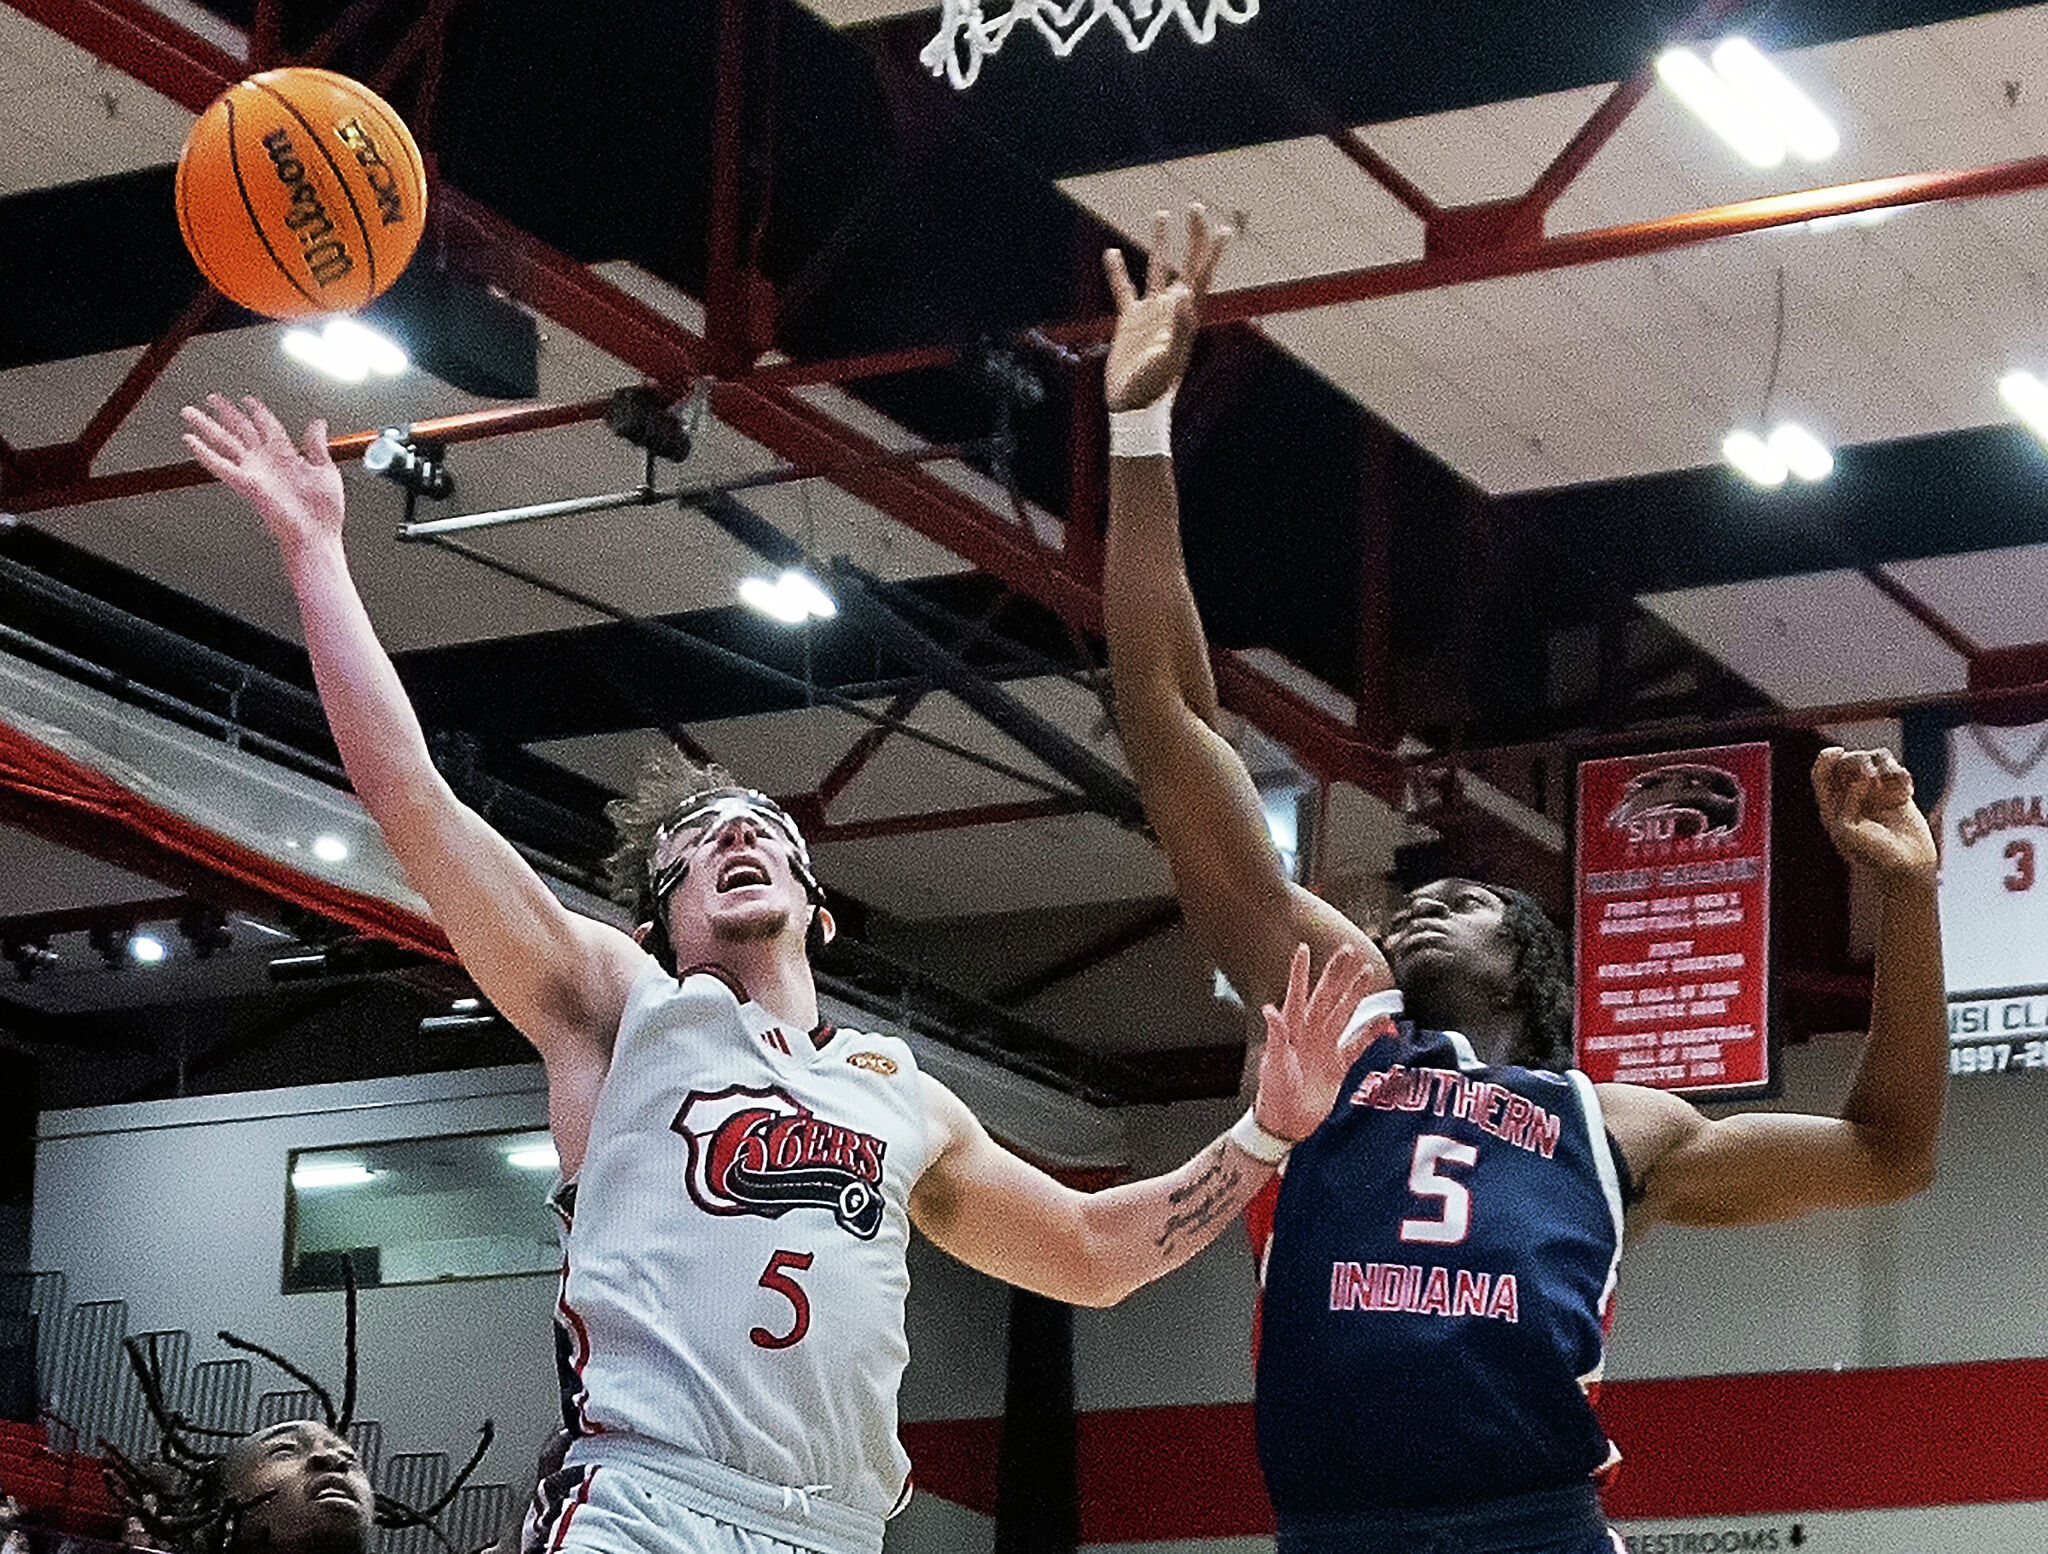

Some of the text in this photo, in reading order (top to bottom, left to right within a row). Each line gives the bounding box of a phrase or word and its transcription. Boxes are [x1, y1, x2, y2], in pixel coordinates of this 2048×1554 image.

[262, 128, 354, 288] Wilson
[2003, 839, 2036, 892] 3
[2003, 1002, 2048, 1030] CL
[1350, 1064, 1561, 1159] SOUTHERN
[1400, 1134, 1479, 1246] 5
[749, 1249, 815, 1350] 5
[1329, 1261, 1519, 1324] INDIANA
[1625, 1528, 1779, 1554] RESTROOMS
